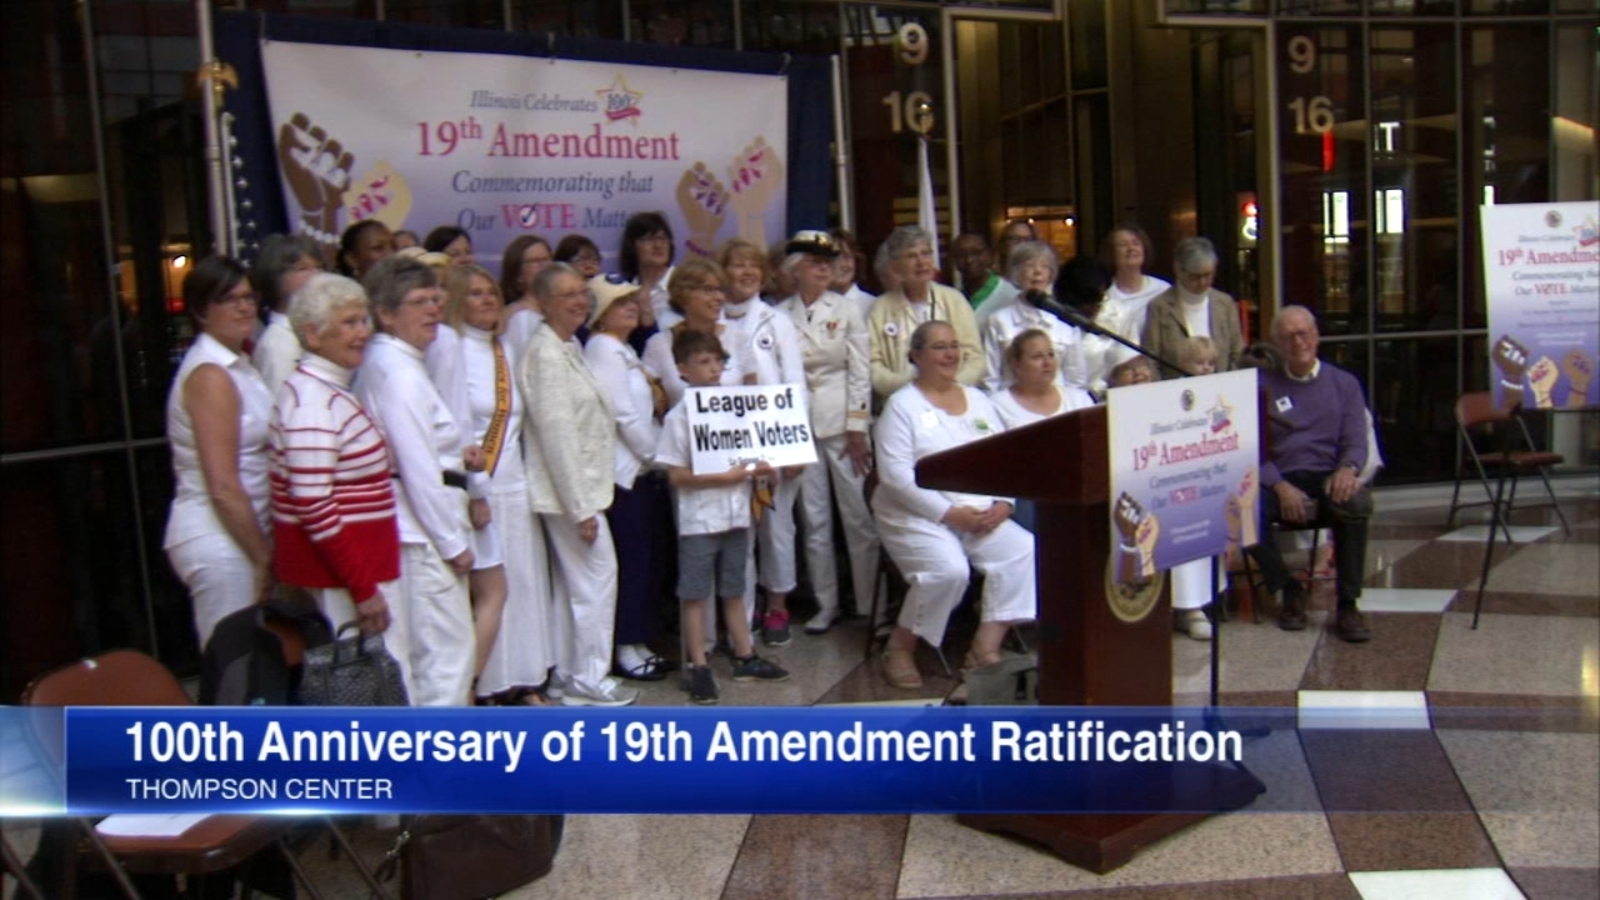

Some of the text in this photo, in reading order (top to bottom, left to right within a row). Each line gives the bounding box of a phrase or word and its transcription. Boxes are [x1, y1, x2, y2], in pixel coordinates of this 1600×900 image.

[899, 22, 929, 64] 9
[1288, 36, 1314, 73] 9
[470, 90, 597, 113] Illinois Celebrates
[1288, 97, 1334, 134] 16
[416, 116, 681, 161] 19th Amendment
[452, 170, 654, 199] Commemorating that
[457, 208, 496, 231] Our
[501, 202, 576, 230] VOTE
[695, 387, 793, 417] League of
[693, 420, 809, 452] Women Voters
[1159, 432, 1240, 466] Amendment
